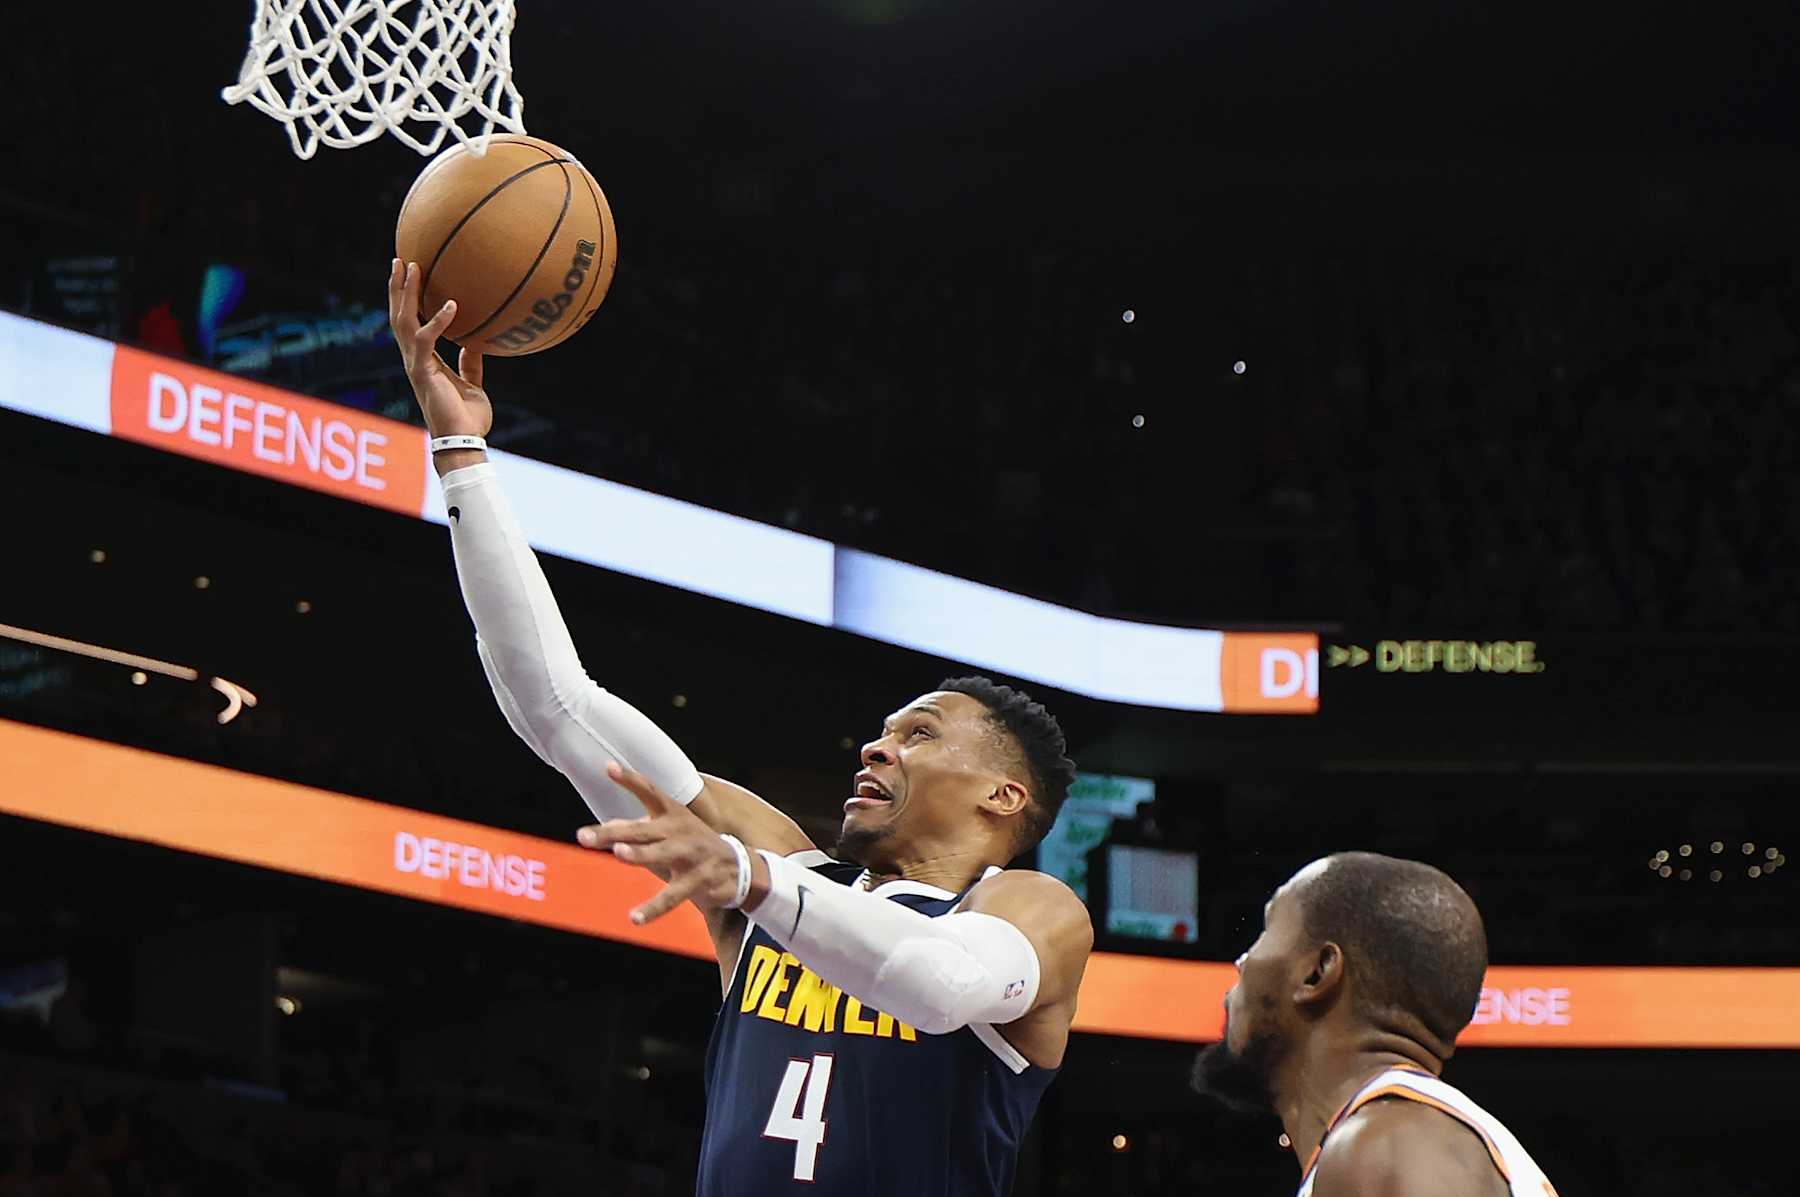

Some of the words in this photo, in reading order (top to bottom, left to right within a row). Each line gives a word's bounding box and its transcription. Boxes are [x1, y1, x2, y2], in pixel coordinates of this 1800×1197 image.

[487, 239, 596, 350] Wilson
[147, 371, 389, 491] DEFENSE
[394, 831, 546, 901] DEFENSE
[761, 1052, 835, 1184] 4
